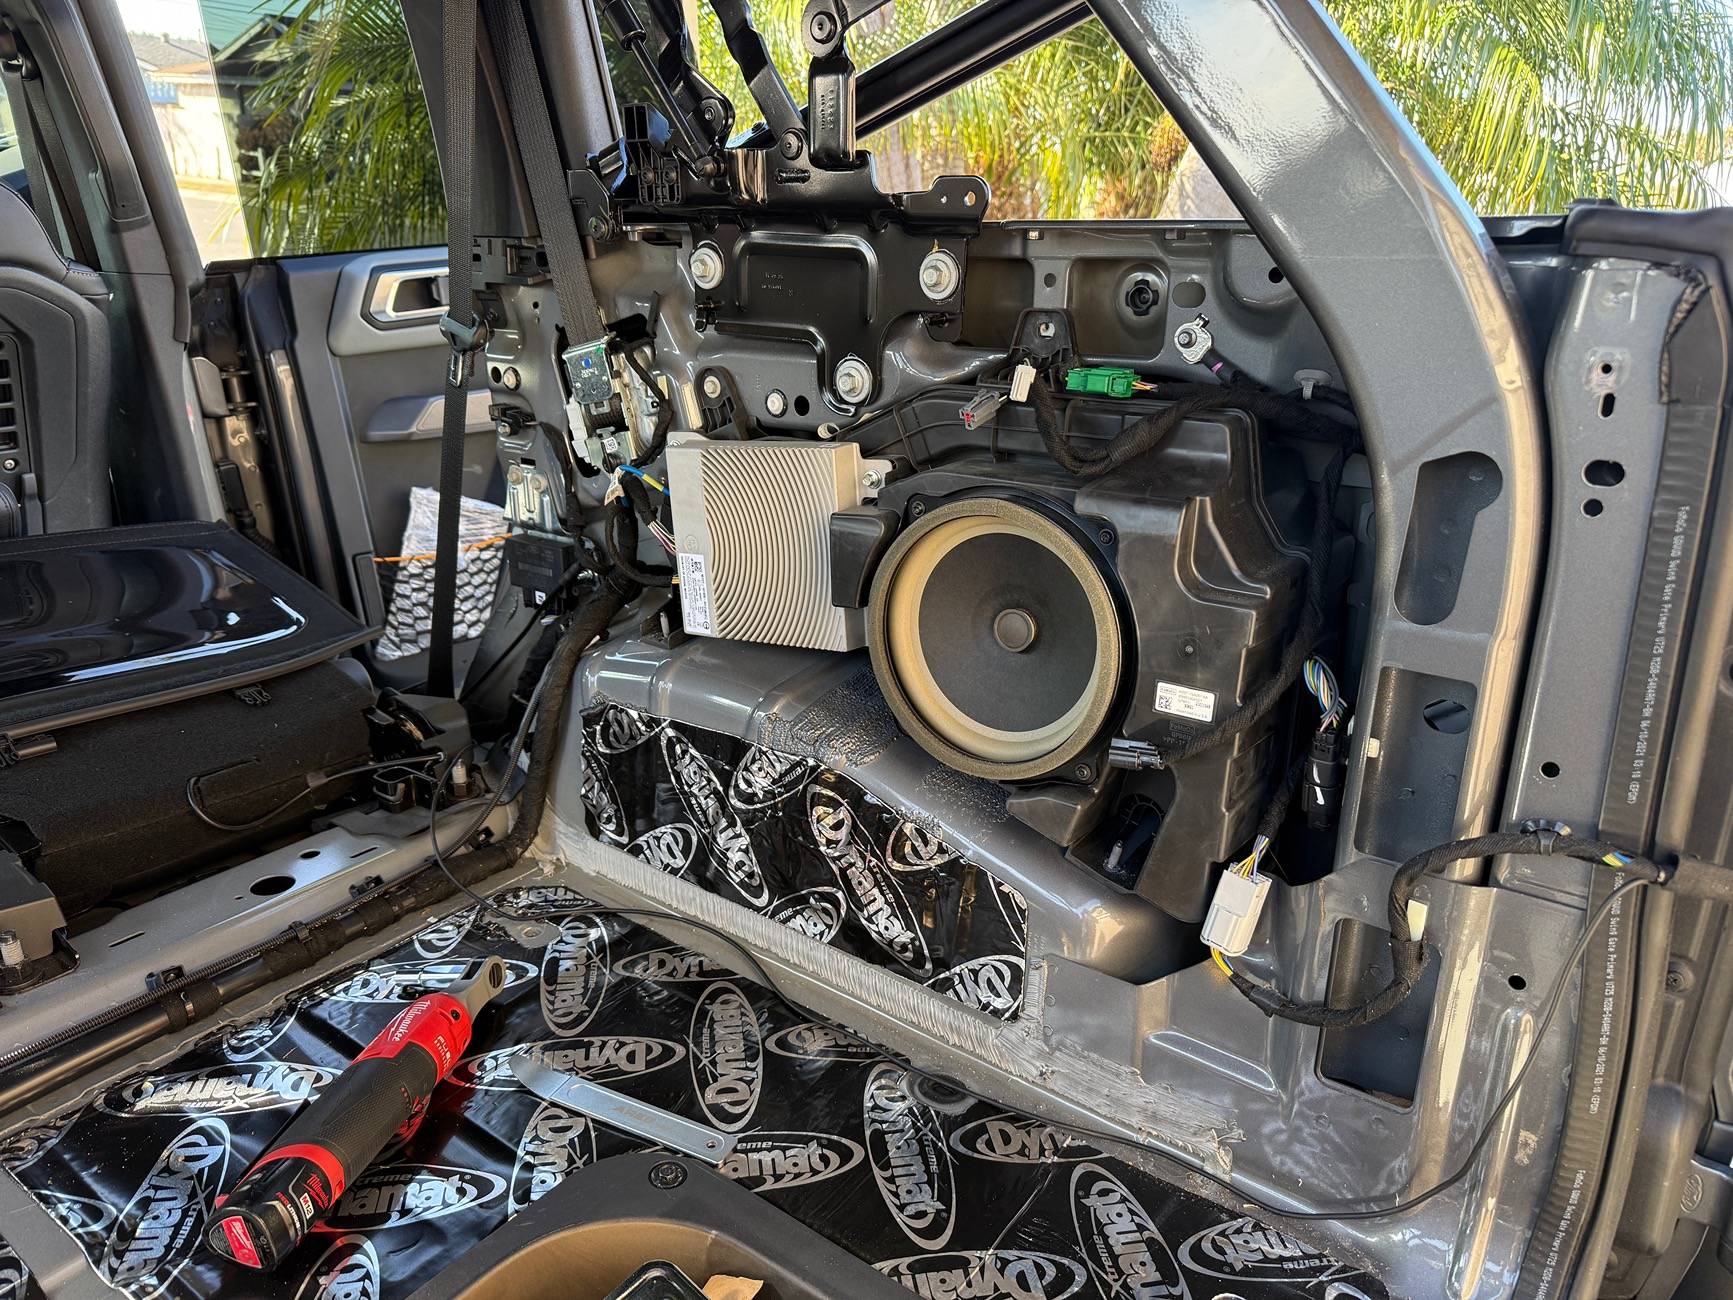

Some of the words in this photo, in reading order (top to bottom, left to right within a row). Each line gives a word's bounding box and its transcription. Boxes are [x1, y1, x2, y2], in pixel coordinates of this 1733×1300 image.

[551, 924, 602, 1021] Dynamat
[392, 1000, 431, 1042] Milwaukee
[705, 998, 758, 1106] Dynamat
[719, 1139, 826, 1179] amat
[868, 1087, 947, 1216] Dynamat
[302, 1194, 314, 1216] M12
